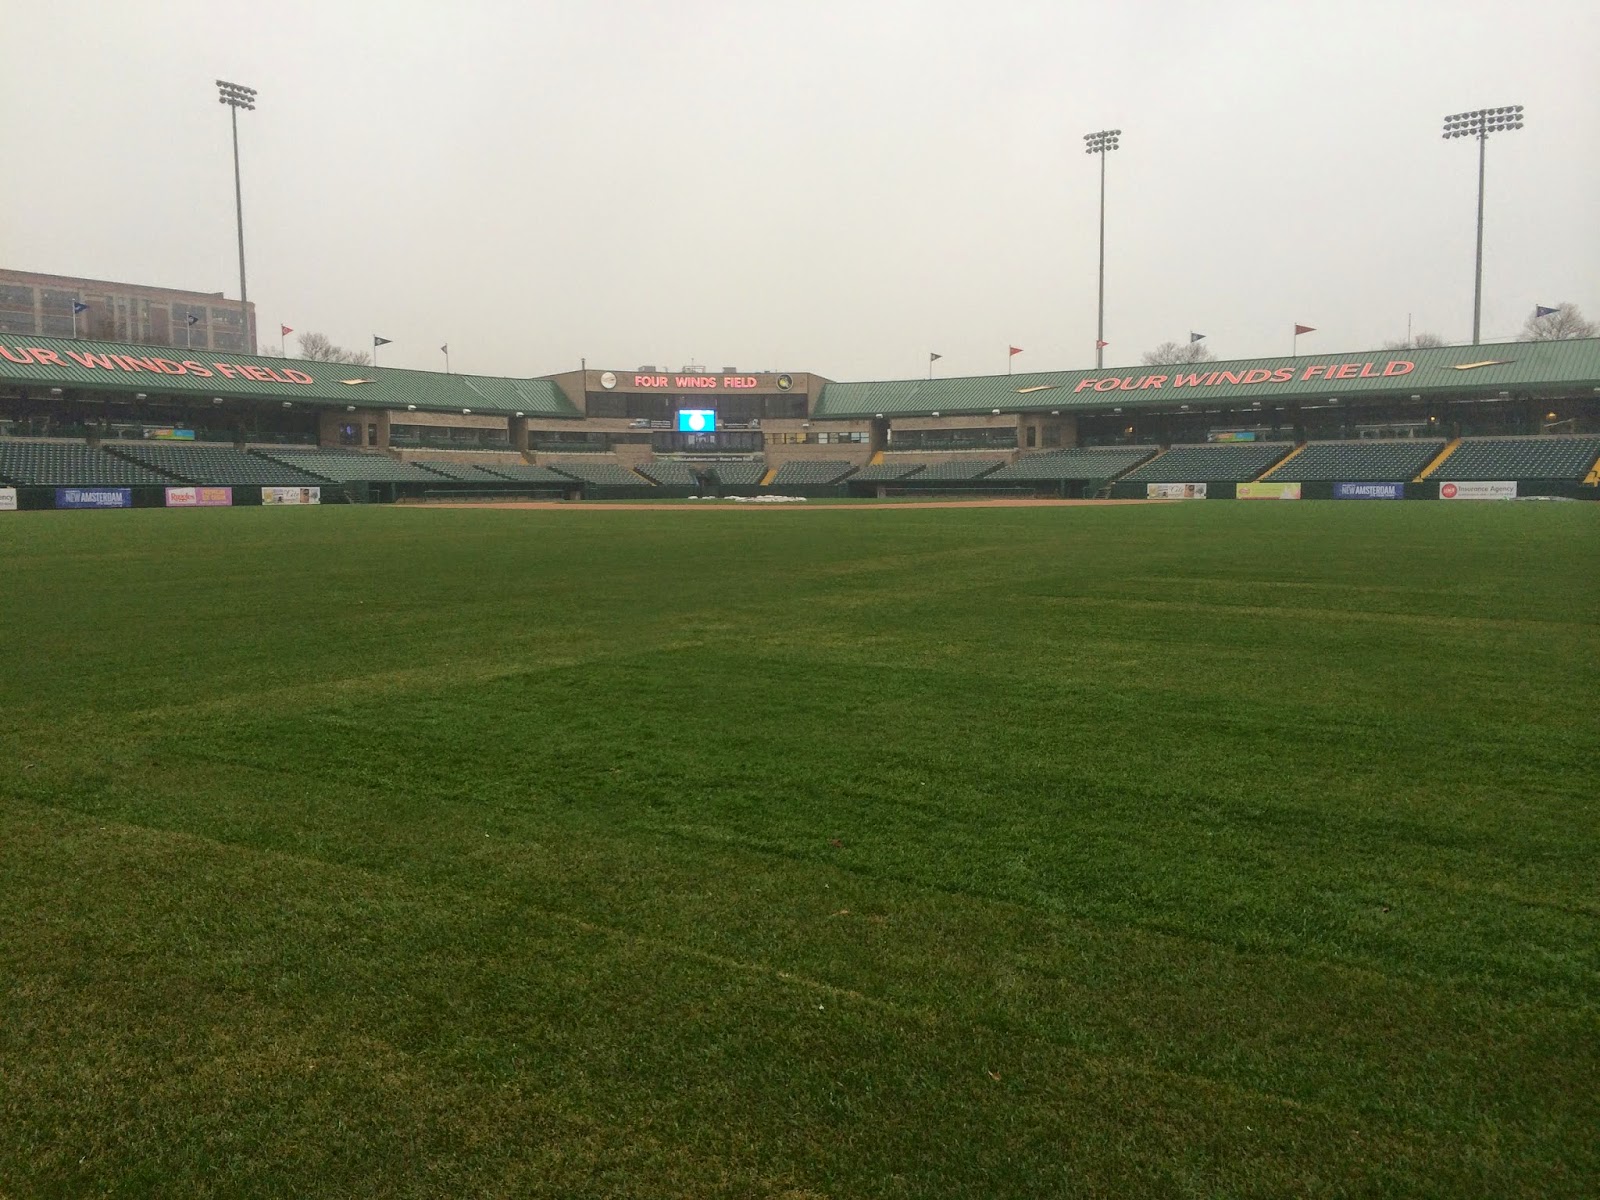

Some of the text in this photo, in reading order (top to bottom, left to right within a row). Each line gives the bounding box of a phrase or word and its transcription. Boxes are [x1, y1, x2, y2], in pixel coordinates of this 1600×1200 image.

[65, 351, 214, 378] WINDS
[213, 362, 314, 385] FIELD
[634, 375, 757, 389] FOUR WINDS FIELD
[1073, 360, 1415, 394] FOUR WINDS FIELD
[1341, 485, 1395, 494] NEW AMSTERDAM
[65, 492, 122, 502] NEW AMSTERDAM
